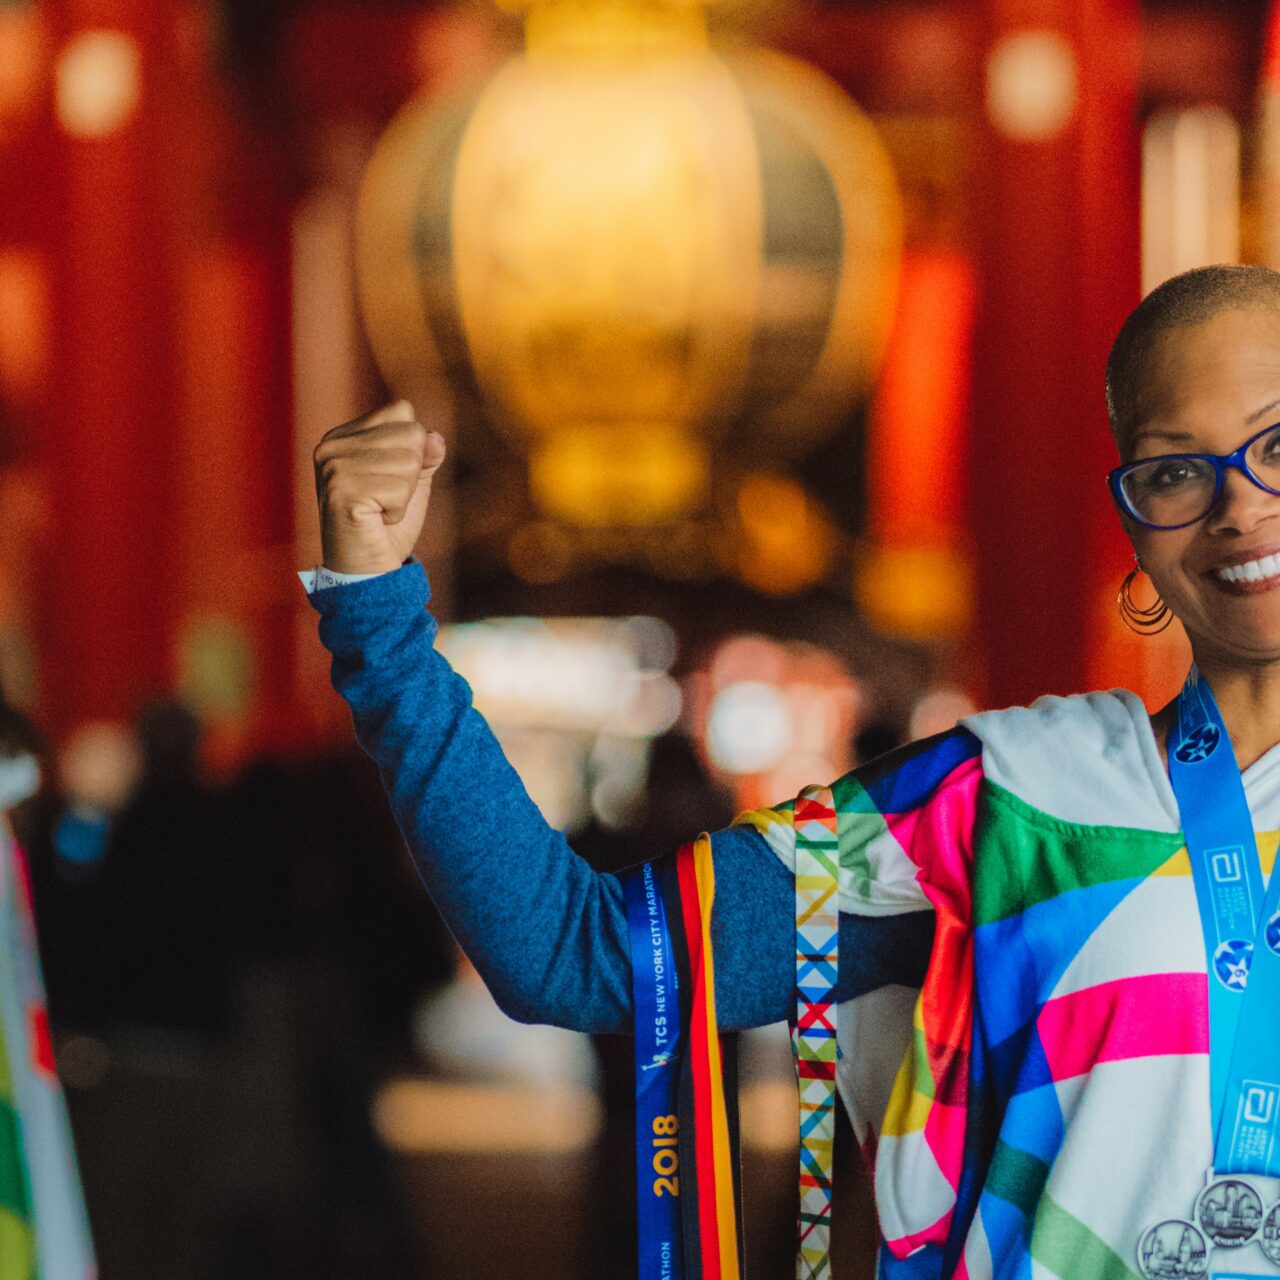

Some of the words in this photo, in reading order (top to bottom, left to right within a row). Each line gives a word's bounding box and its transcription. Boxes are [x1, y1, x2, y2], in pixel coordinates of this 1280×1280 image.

[650, 919, 662, 945] CITY
[653, 948, 666, 982] YORK
[655, 984, 666, 1013] NEW
[655, 1016, 668, 1046] TCS
[653, 1114, 680, 1197] 2018
